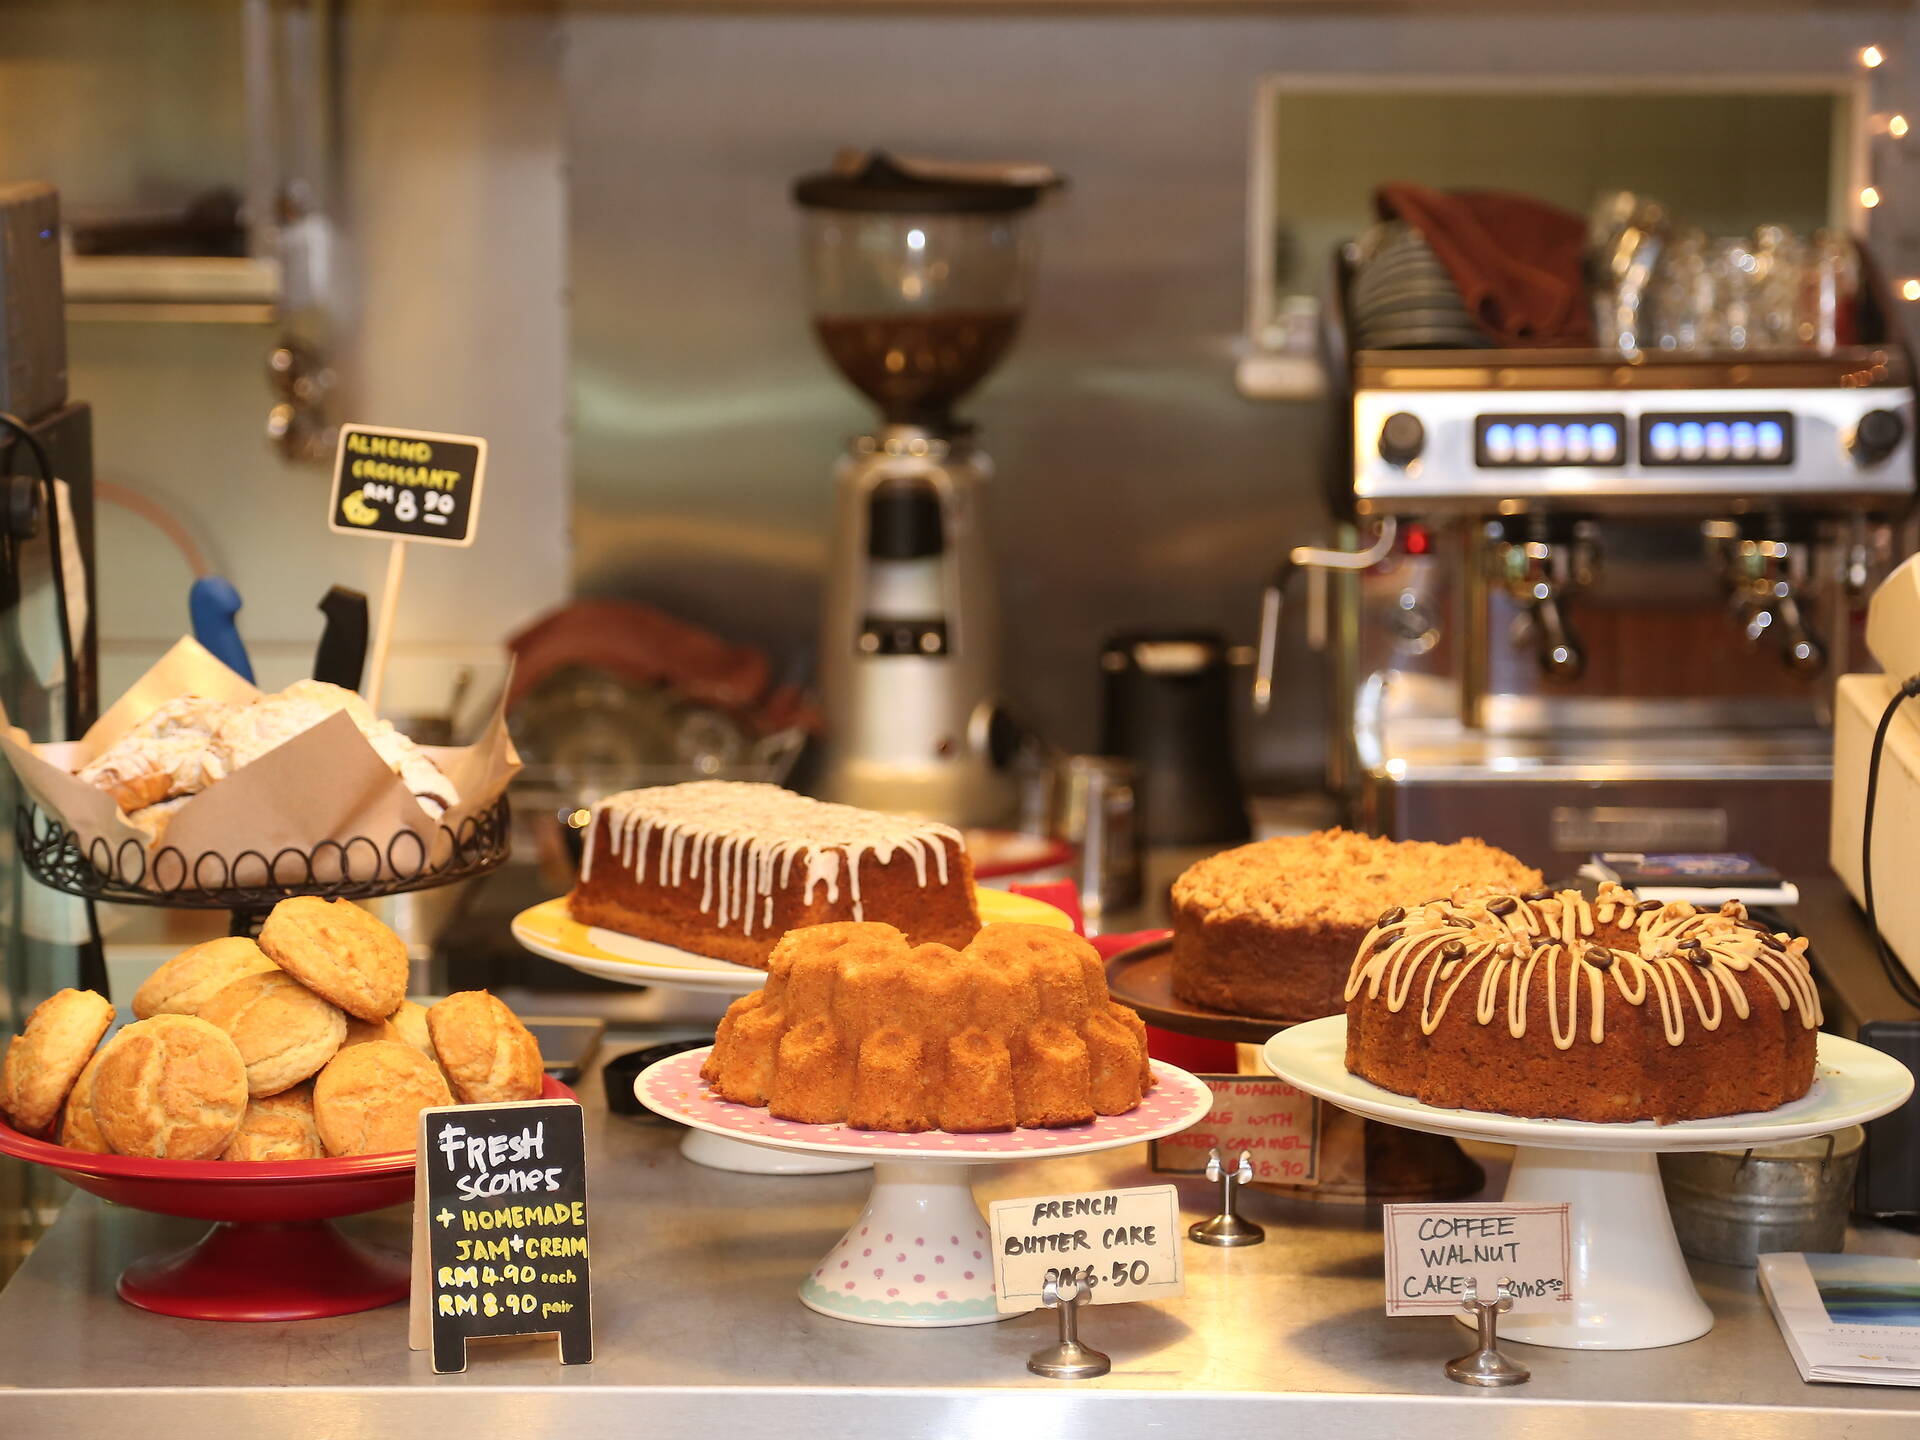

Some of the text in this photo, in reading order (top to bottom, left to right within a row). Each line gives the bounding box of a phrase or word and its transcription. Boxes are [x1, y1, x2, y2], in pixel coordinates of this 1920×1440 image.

[348, 433, 432, 463] ALMOND
[1235, 1082, 1307, 1099] WALNU
[438, 1121, 544, 1173] FRESH
[462, 1202, 585, 1231] HOMEMADE
[1032, 1196, 1118, 1226] FRENCH
[1005, 1225, 1157, 1255] BUTTER CAKE
[1418, 1216, 1517, 1241] COFFEE
[1420, 1242, 1520, 1268] WALNUT
[438, 1265, 577, 1288] RM 4.90 each
[1403, 1274, 1465, 1298] CAKE
[438, 1293, 574, 1319] RM 8.90 pair
